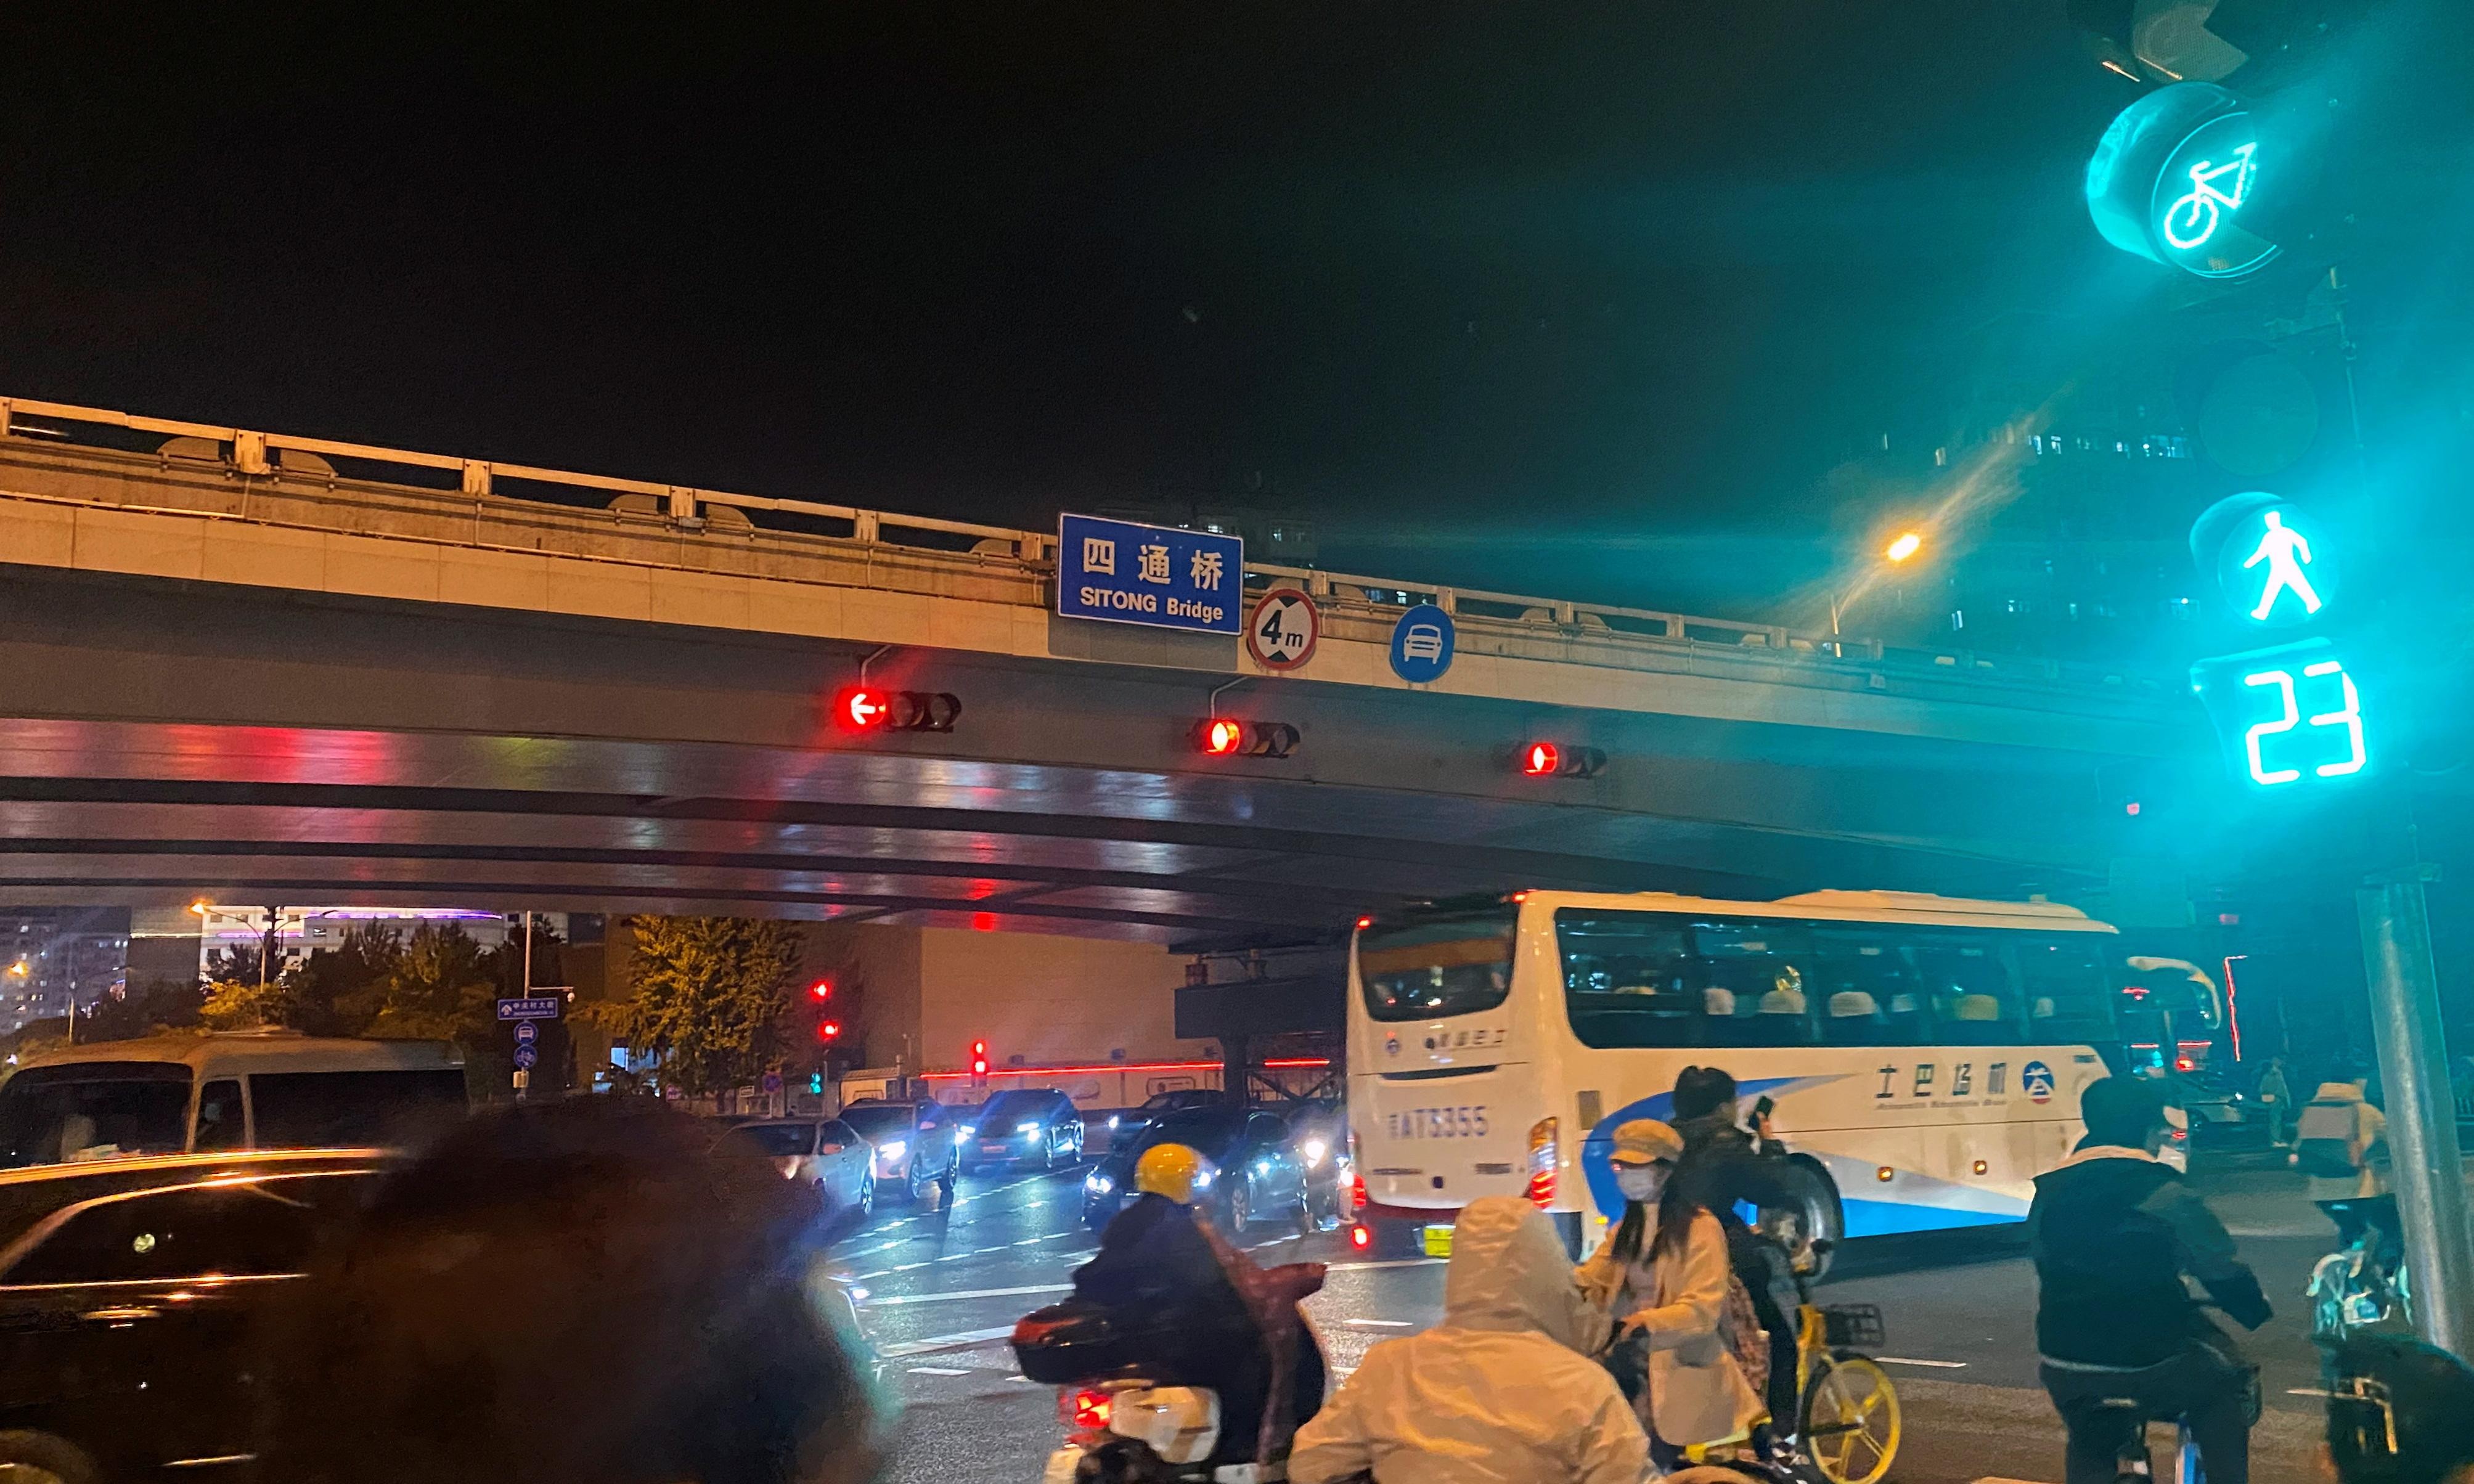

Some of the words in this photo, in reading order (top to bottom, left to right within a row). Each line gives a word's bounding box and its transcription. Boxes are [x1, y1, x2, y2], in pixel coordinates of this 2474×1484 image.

[1083, 537, 1223, 591] 四通桥
[1080, 586, 1157, 613] SITONG
[1167, 597, 1223, 624] Bridge
[2243, 661, 2367, 786] 23
